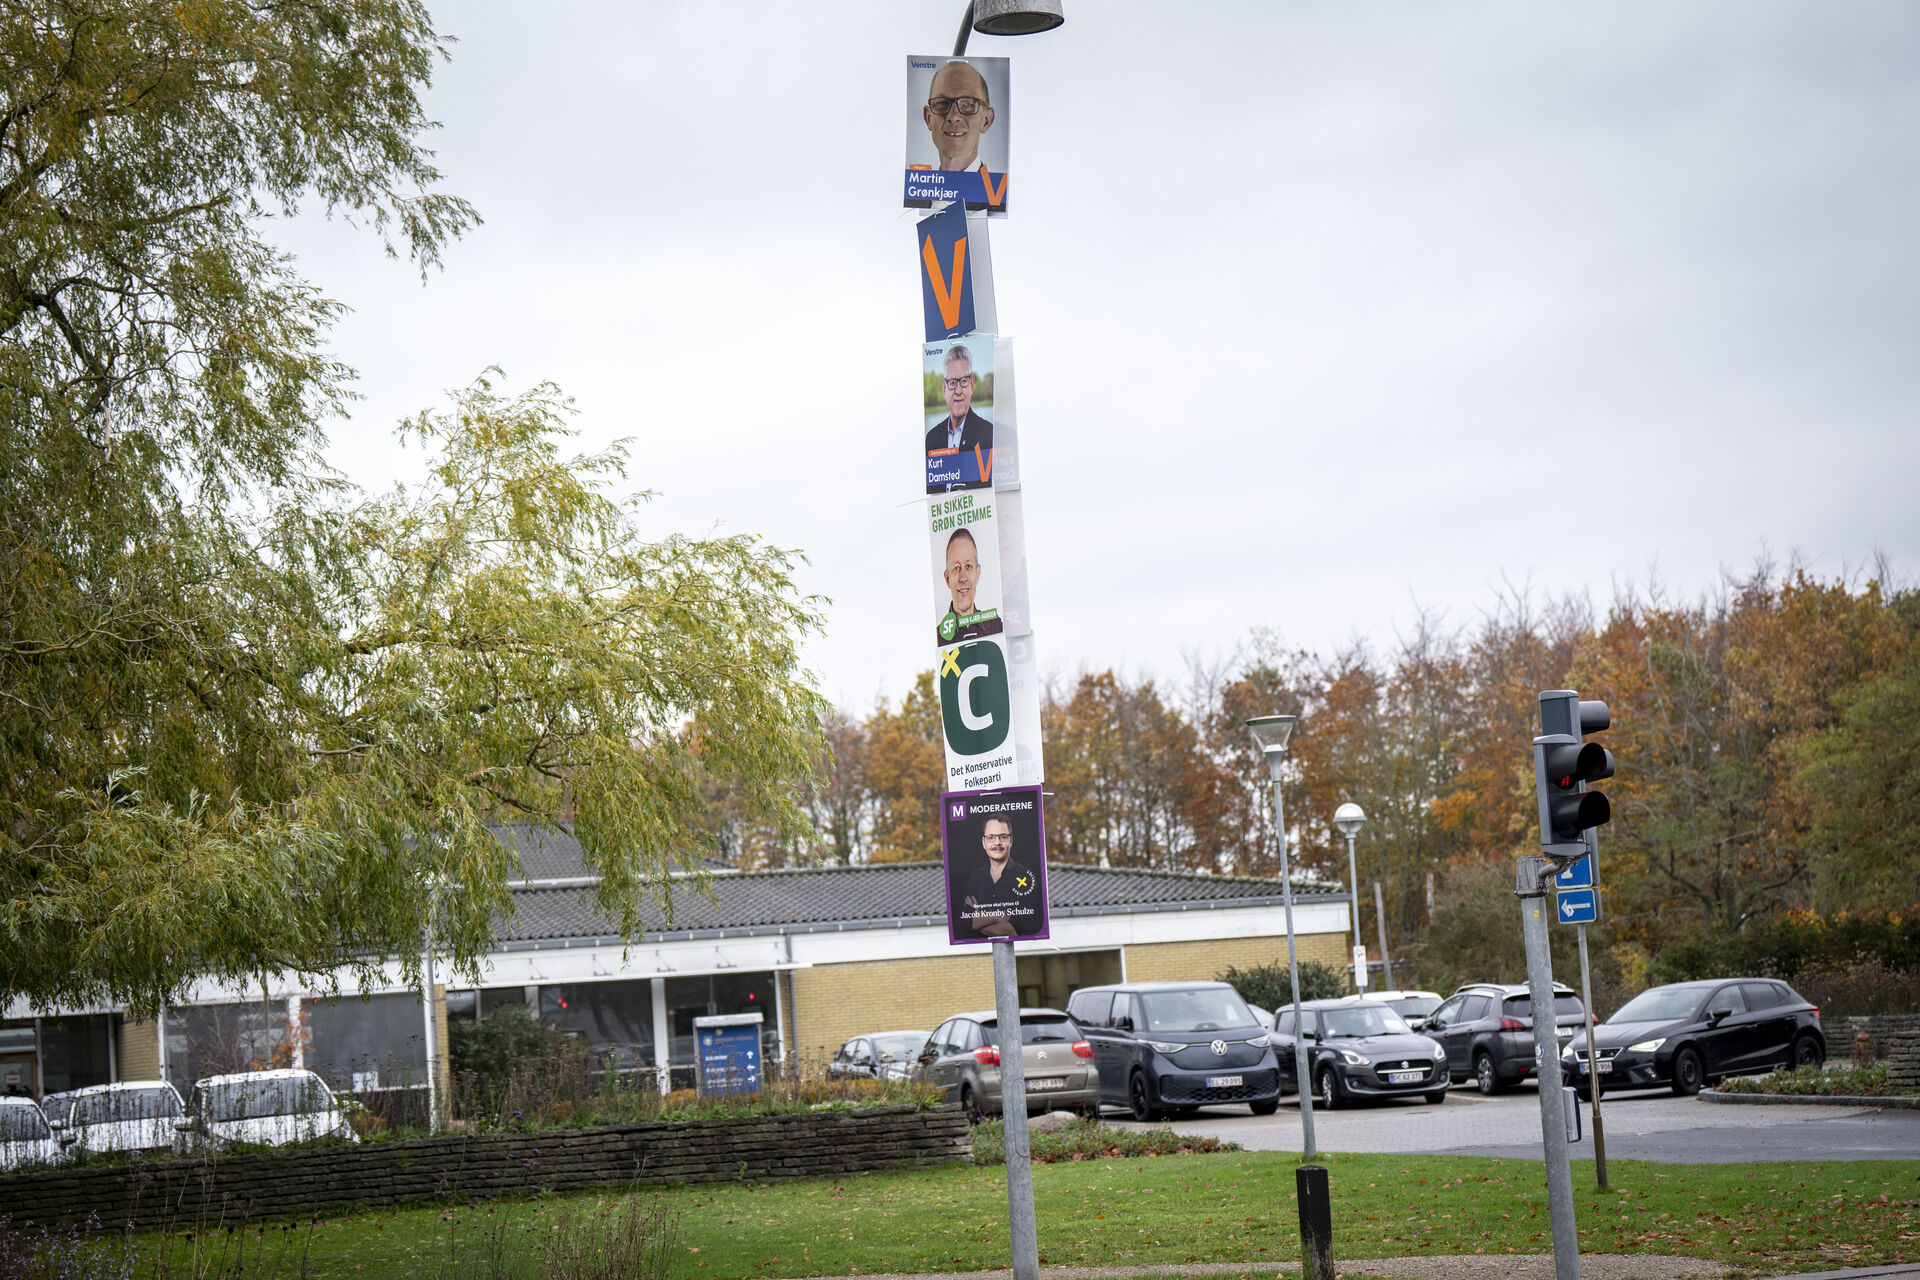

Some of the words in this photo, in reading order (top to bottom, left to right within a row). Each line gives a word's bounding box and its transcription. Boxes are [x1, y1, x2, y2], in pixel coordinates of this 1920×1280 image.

[911, 60, 937, 69] Venstre
[909, 172, 945, 184] Martin
[980, 163, 1008, 206] V
[908, 186, 959, 200] Grønkjær
[922, 233, 967, 330] V
[925, 348, 943, 356] Venstre
[928, 458, 943, 469] Kurt
[974, 441, 993, 483] V
[928, 469, 960, 483] Damsted
[931, 503, 942, 518] EN
[944, 494, 974, 514] SIKKER
[932, 515, 955, 533] GRØN
[957, 505, 993, 527] STEMME
[943, 619, 954, 634] SF
[957, 663, 994, 731] C
[950, 764, 964, 777] Det
[965, 755, 1013, 774] Konservative
[964, 771, 1002, 788] Folkeparti
[952, 805, 964, 817] M
[970, 801, 1033, 814] MODERATERNE
[960, 911, 980, 919] Jacob
[981, 909, 1005, 918] Kronby
[1006, 907, 1035, 916] Schulze
[1533, 909, 1540, 917] 2
